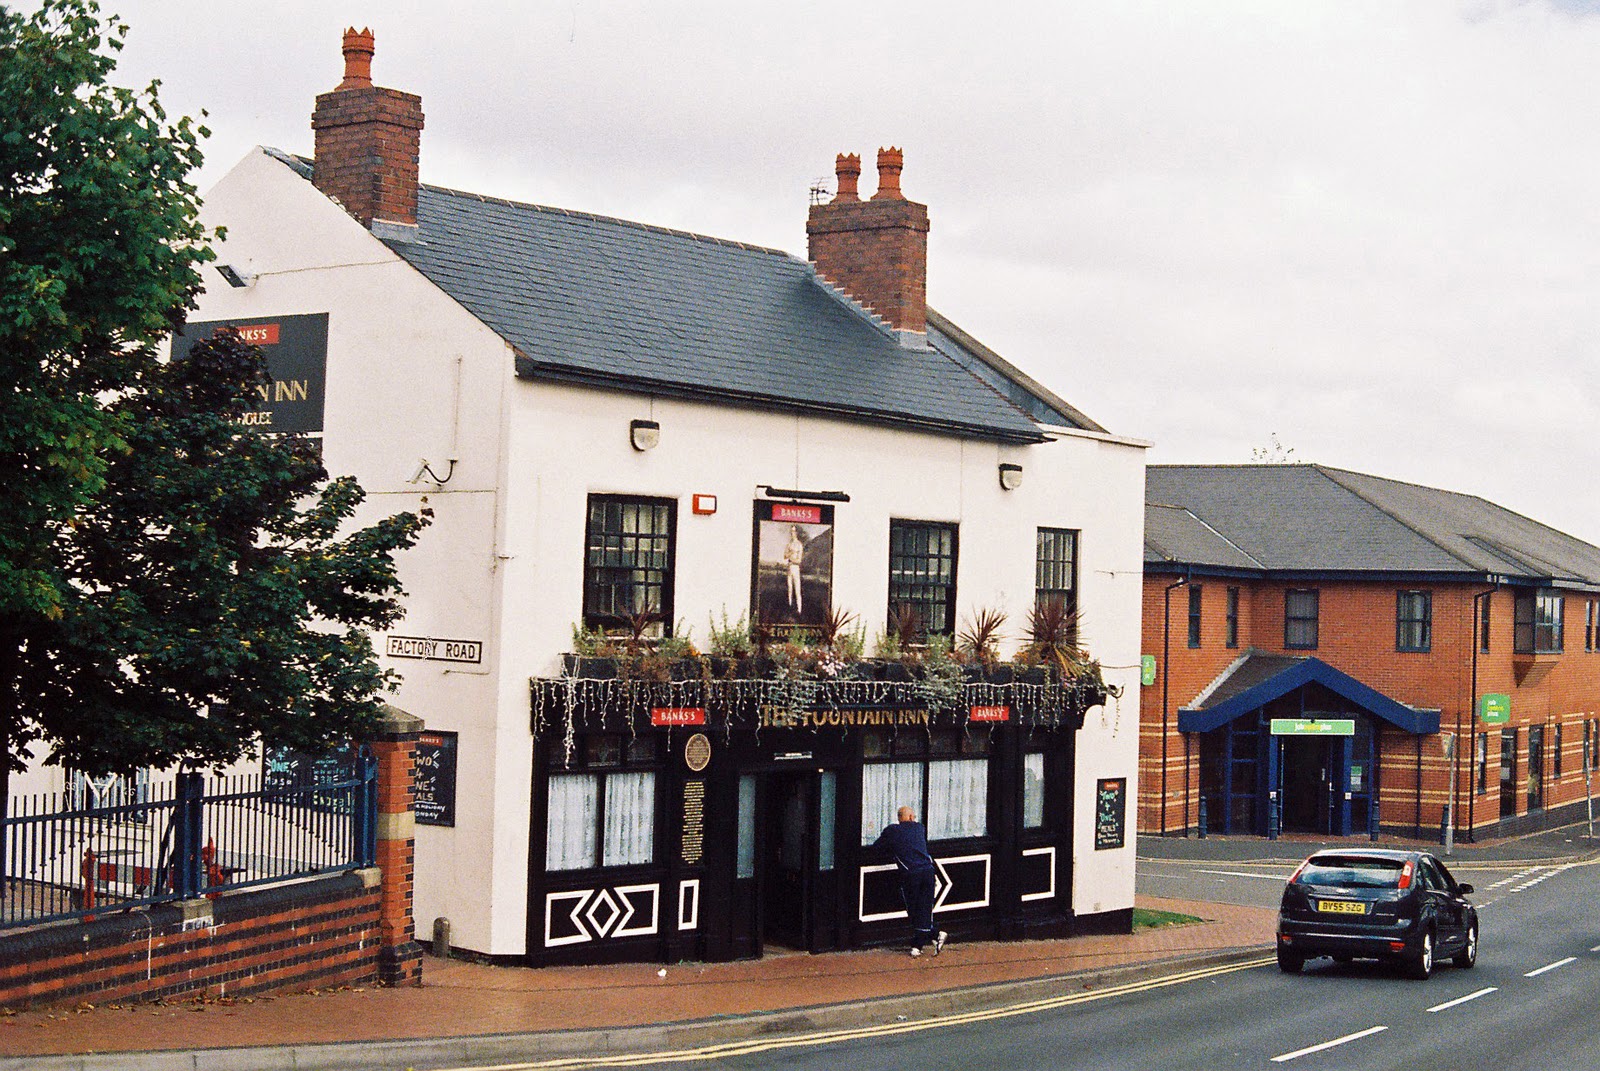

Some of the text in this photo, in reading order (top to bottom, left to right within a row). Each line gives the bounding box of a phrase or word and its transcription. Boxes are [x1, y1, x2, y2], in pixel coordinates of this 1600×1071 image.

[275, 380, 308, 402] INN
[780, 507, 812, 519] BANKS'S
[391, 639, 476, 660] FACTORY ROAD
[661, 711, 696, 721] BANKS'S
[898, 708, 929, 726] INN
[416, 756, 433, 767] WO
[415, 780, 431, 792] NE
[416, 792, 434, 802] ALS
